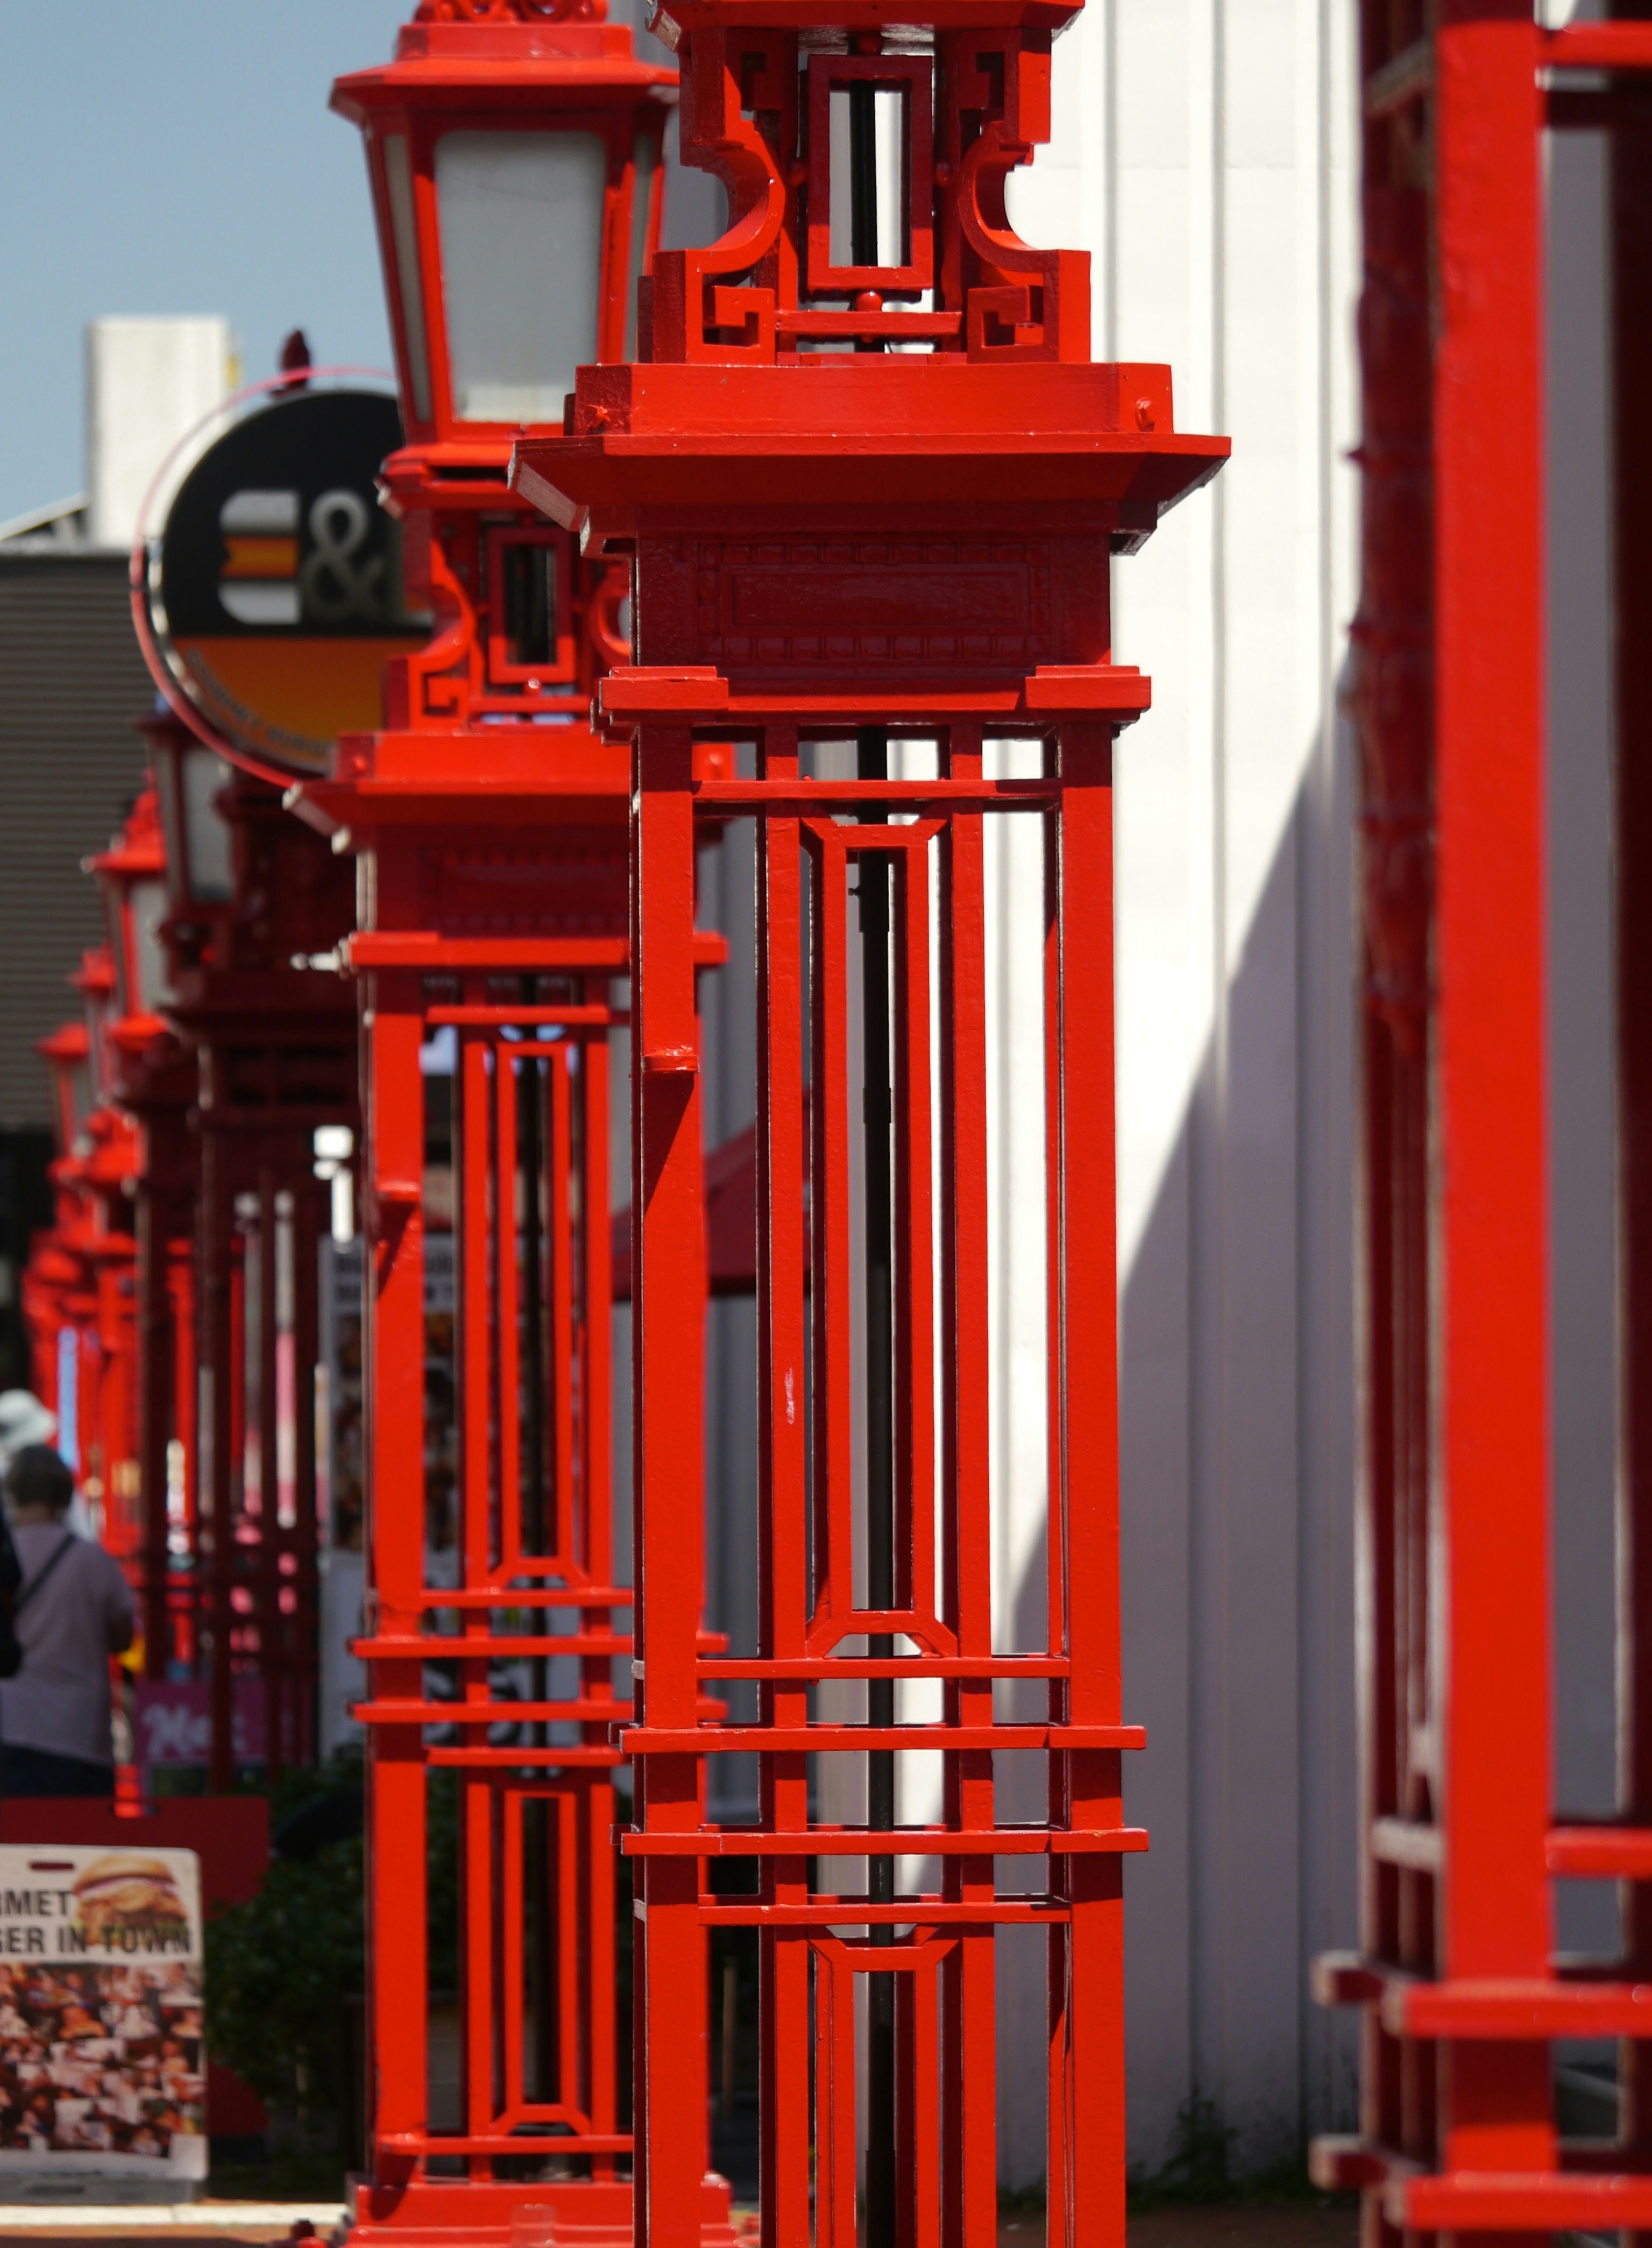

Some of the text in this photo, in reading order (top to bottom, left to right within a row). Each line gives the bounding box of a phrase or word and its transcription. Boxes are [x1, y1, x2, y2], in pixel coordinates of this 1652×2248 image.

[300, 487, 385, 622] &
[0, 1889, 73, 1916] MET
[0, 1926, 191, 1953] ER IN TOWN
